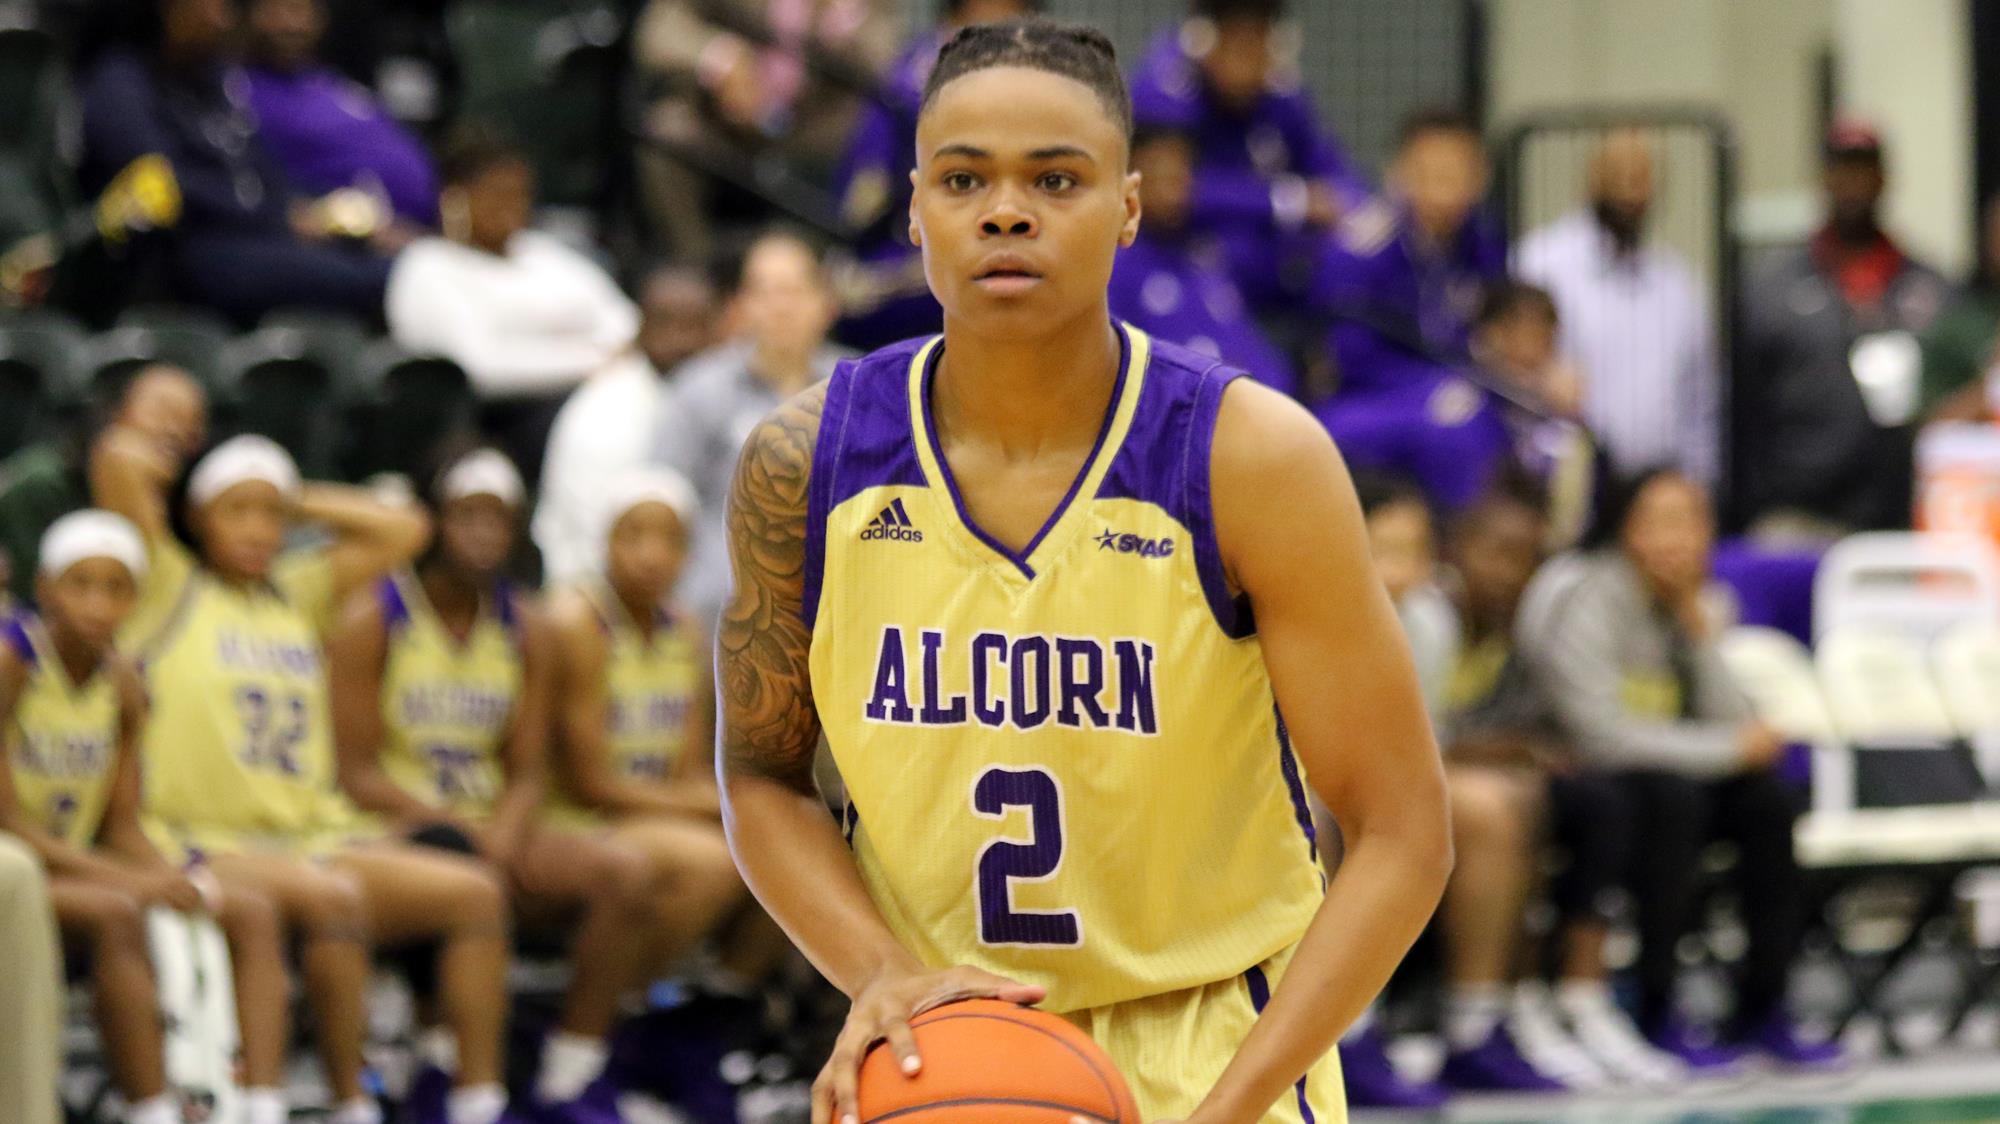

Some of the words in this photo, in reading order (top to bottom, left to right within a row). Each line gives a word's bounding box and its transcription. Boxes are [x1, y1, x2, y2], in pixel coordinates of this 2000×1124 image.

[860, 524, 923, 543] adidas
[863, 624, 1160, 738] ALCORN
[970, 764, 1083, 950] 2
